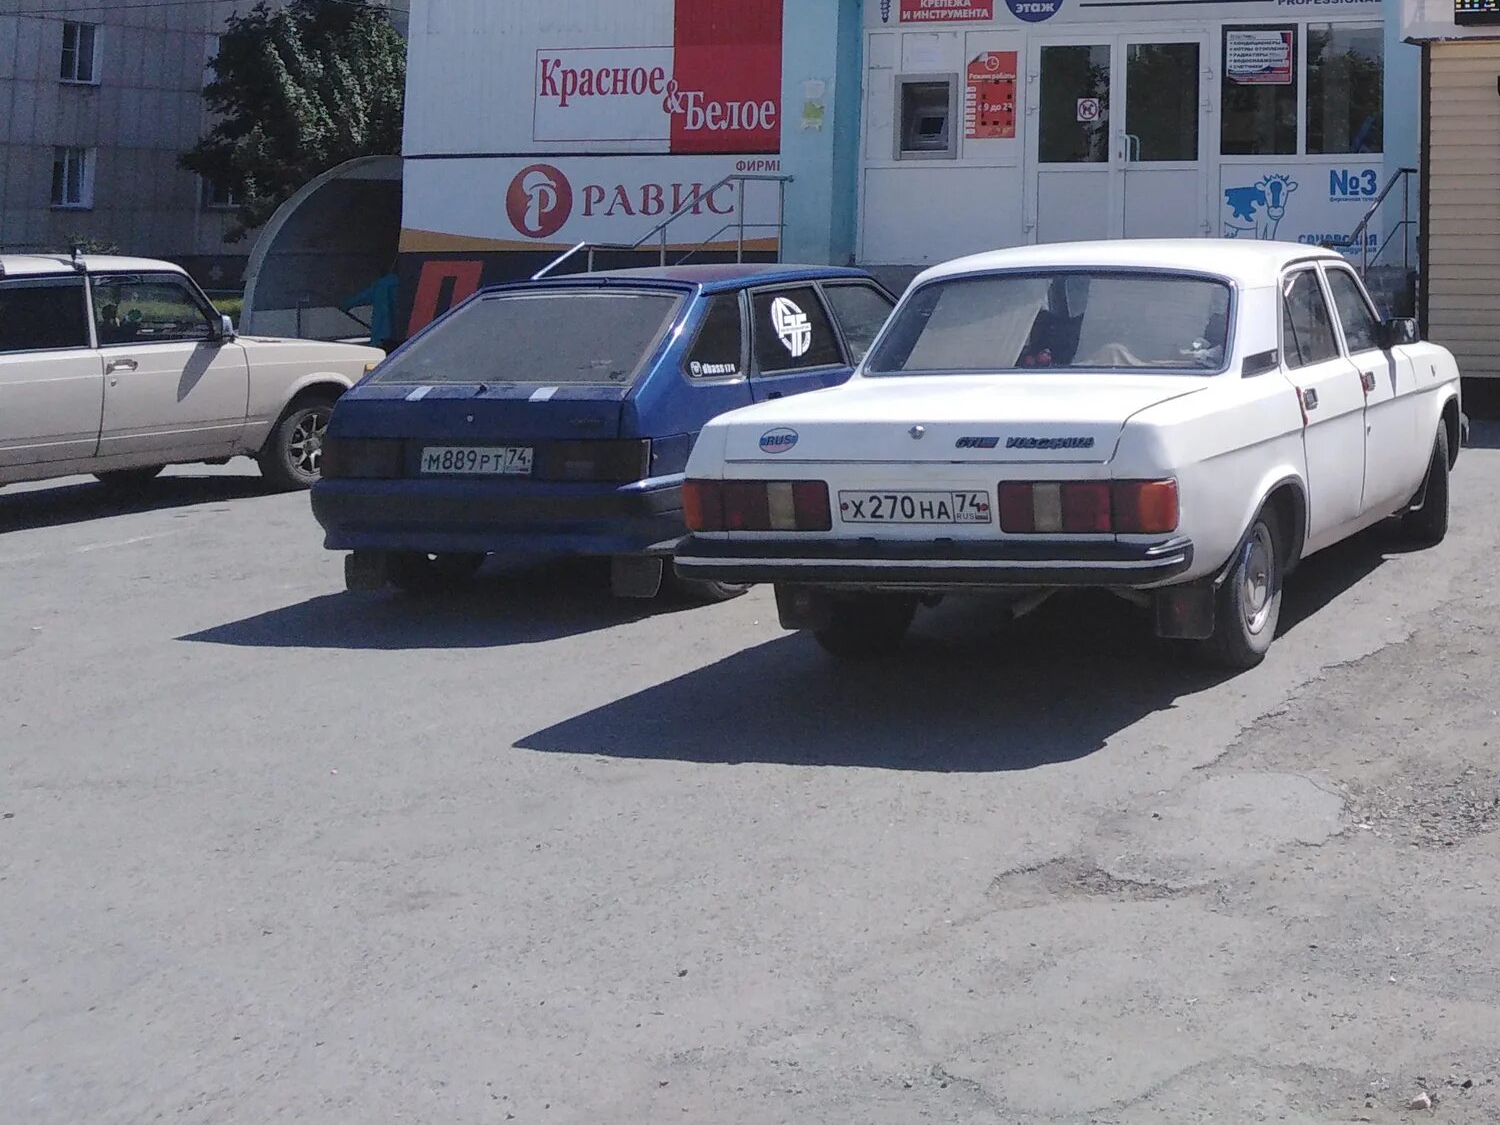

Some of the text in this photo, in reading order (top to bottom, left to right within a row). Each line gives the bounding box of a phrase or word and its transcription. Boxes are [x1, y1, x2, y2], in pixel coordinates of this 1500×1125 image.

[902, 9, 989, 20] И ИНСТРУМЕНТА
[539, 58, 665, 107] Красное
[662, 79, 685, 114] &
[684, 91, 776, 131] Белое
[1329, 169, 1377, 196] №3
[581, 183, 735, 217] РАВИС
[766, 435, 792, 446] RUS
[427, 448, 527, 471] М889РТ 74
[851, 493, 981, 519] Х270НА 74
